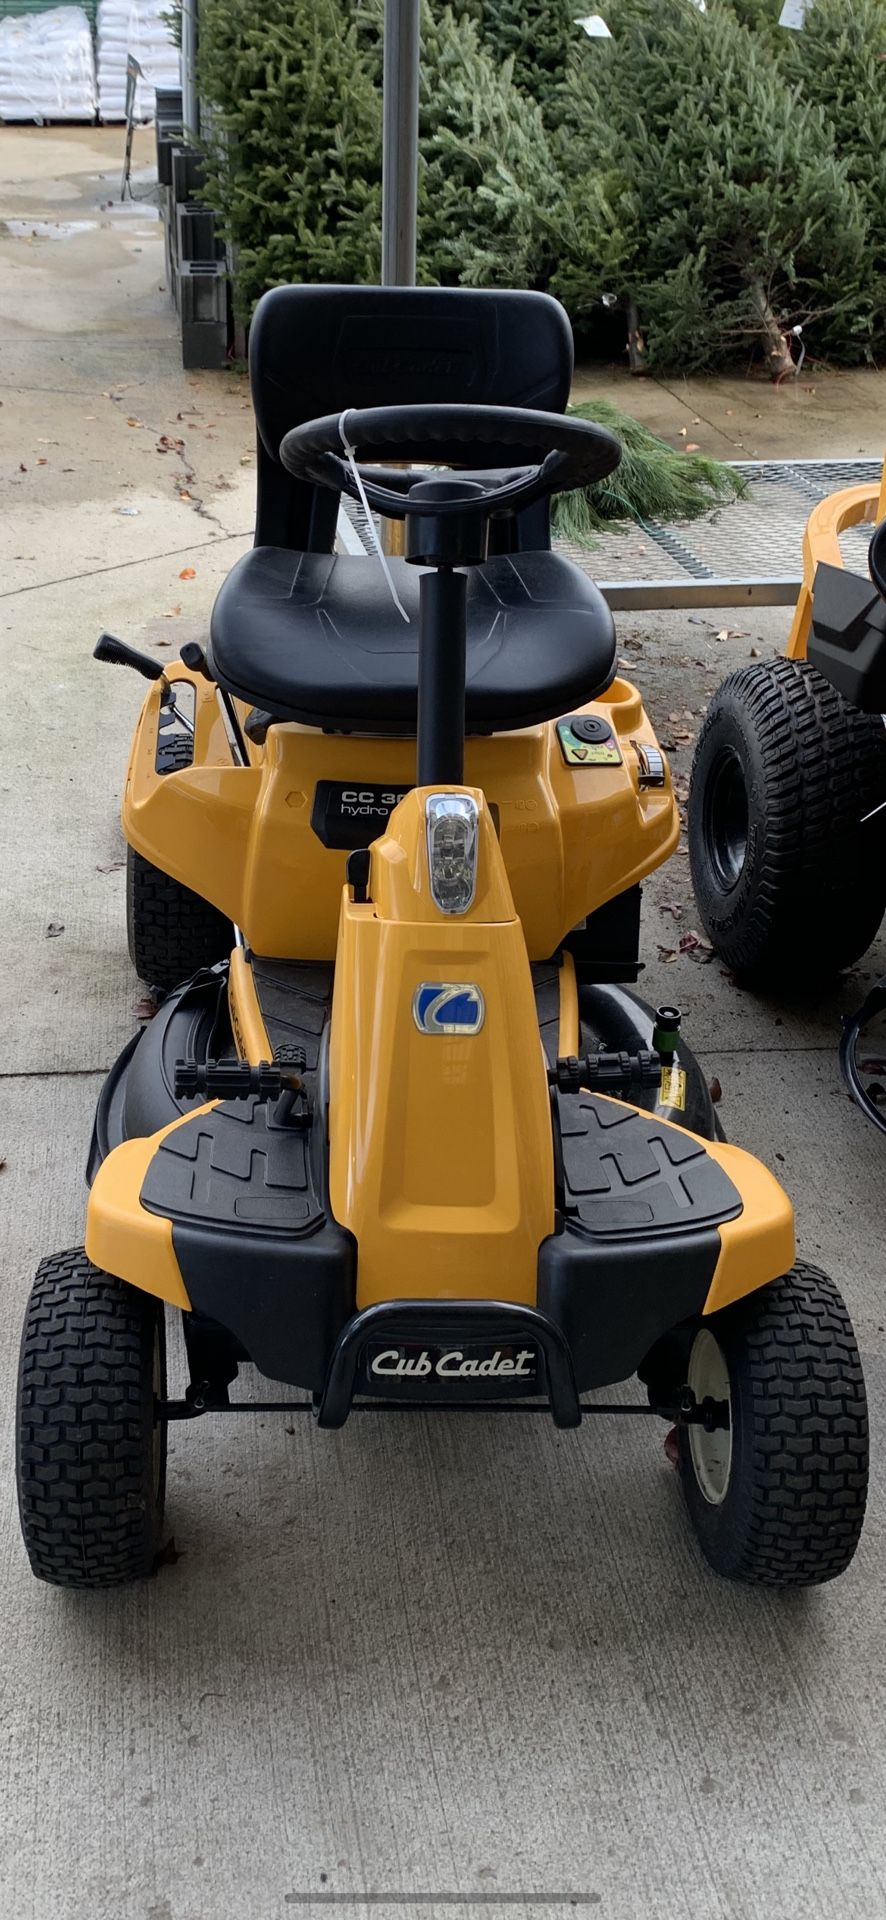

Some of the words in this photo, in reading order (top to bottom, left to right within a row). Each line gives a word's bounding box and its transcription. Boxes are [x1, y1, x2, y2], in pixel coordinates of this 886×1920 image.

[341, 791, 375, 804] CC
[340, 803, 389, 816] hydro
[371, 1350, 432, 1376] Cub
[435, 1350, 535, 1377] Cadet
